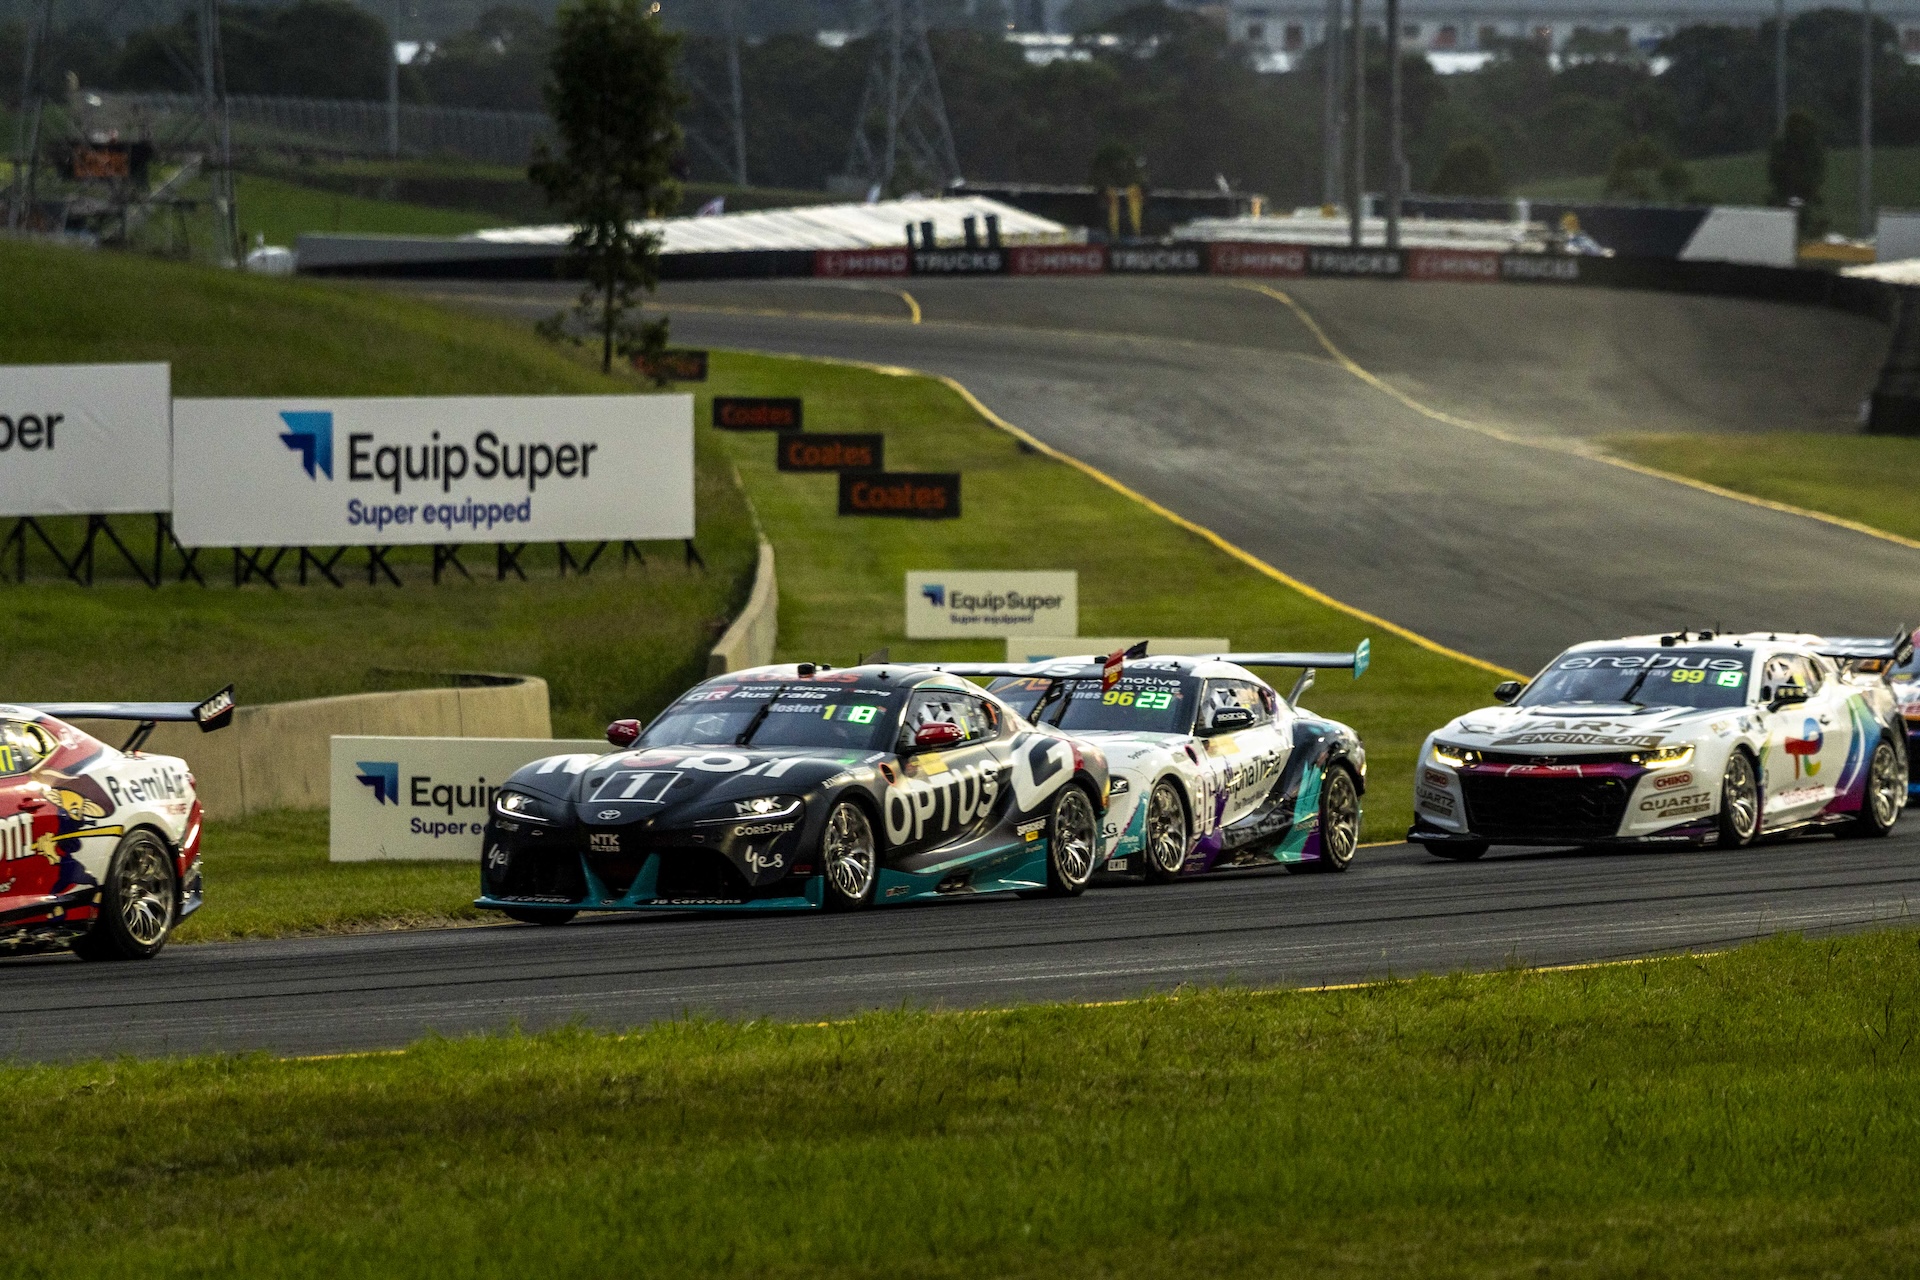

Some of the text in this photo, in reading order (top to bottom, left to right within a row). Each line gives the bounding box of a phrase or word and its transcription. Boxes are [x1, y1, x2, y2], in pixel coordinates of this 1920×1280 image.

[1112, 250, 1199, 269] TRUCKS
[721, 404, 793, 425] Coates
[788, 442, 872, 465] Coates
[852, 482, 946, 509] Coates
[348, 497, 532, 530] Super equipped
[950, 614, 1033, 625] Super equipped
[1559, 653, 1744, 670] erebus
[1671, 669, 1705, 683] 99
[731, 691, 828, 700] Ausralia
[1102, 692, 1135, 706] 96
[1135, 692, 1173, 709] 23
[822, 705, 837, 720] 1
[1516, 733, 1653, 746] ENGINE OIL
[619, 772, 655, 799] 1
[1656, 774, 1690, 788] CHIKO
[885, 760, 998, 846] OPTUS
[1640, 791, 1711, 811] QUARTZ
[410, 817, 467, 838] Super
[590, 833, 619, 845] NTK
